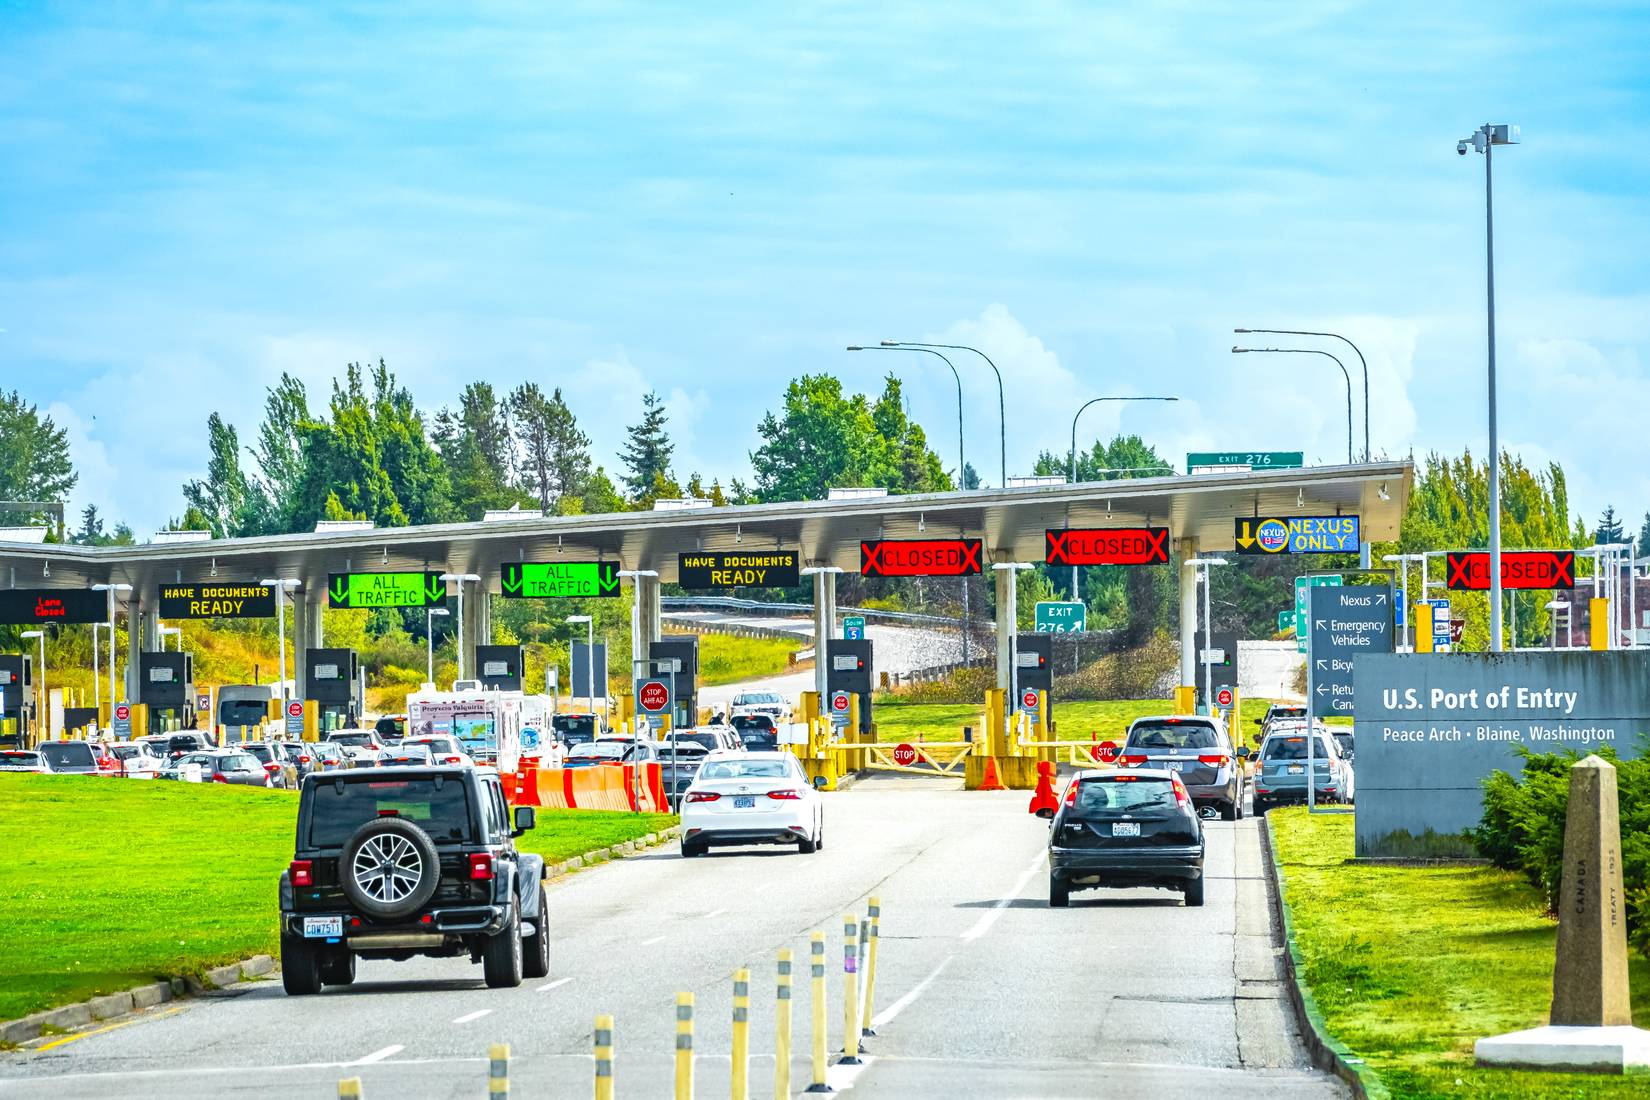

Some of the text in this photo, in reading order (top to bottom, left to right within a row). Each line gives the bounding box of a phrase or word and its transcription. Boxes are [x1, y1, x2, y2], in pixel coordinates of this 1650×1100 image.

[1246, 454, 1271, 464] 276
[1260, 528, 1285, 537] NEXUS
[1289, 519, 1354, 534] NEXUS
[1069, 538, 1145, 556] CLOSED
[1295, 535, 1347, 550] ONLY
[685, 555, 792, 568] HAVE DOCUMENTS
[883, 549, 958, 567] CLOSED
[546, 566, 572, 579] ALL
[711, 570, 766, 584] READY
[373, 576, 400, 589] ALL
[531, 581, 591, 594] TRAFFIC
[164, 587, 269, 598] HAVE DOCUMENTS
[357, 590, 417, 604] TRAFFIC
[1340, 594, 1371, 606] Nexus
[35, 606, 65, 616] Closed
[190, 600, 243, 615] READY
[1048, 607, 1072, 616] EXIT
[1038, 622, 1065, 633] 276
[1331, 619, 1386, 633] Emergency
[851, 630, 857, 640] 5
[1331, 634, 1371, 646] Vehicles
[1332, 659, 1354, 673] Bicy
[646, 688, 662, 696] STOP
[1332, 684, 1354, 695] Retu
[1332, 698, 1354, 710] Can
[1383, 686, 1578, 714] U.S. Port of Entry
[1383, 726, 1615, 744] Peace Arch Blaine, Washington
[895, 750, 914, 759] STOP
[1576, 860, 1586, 914] CANADA
